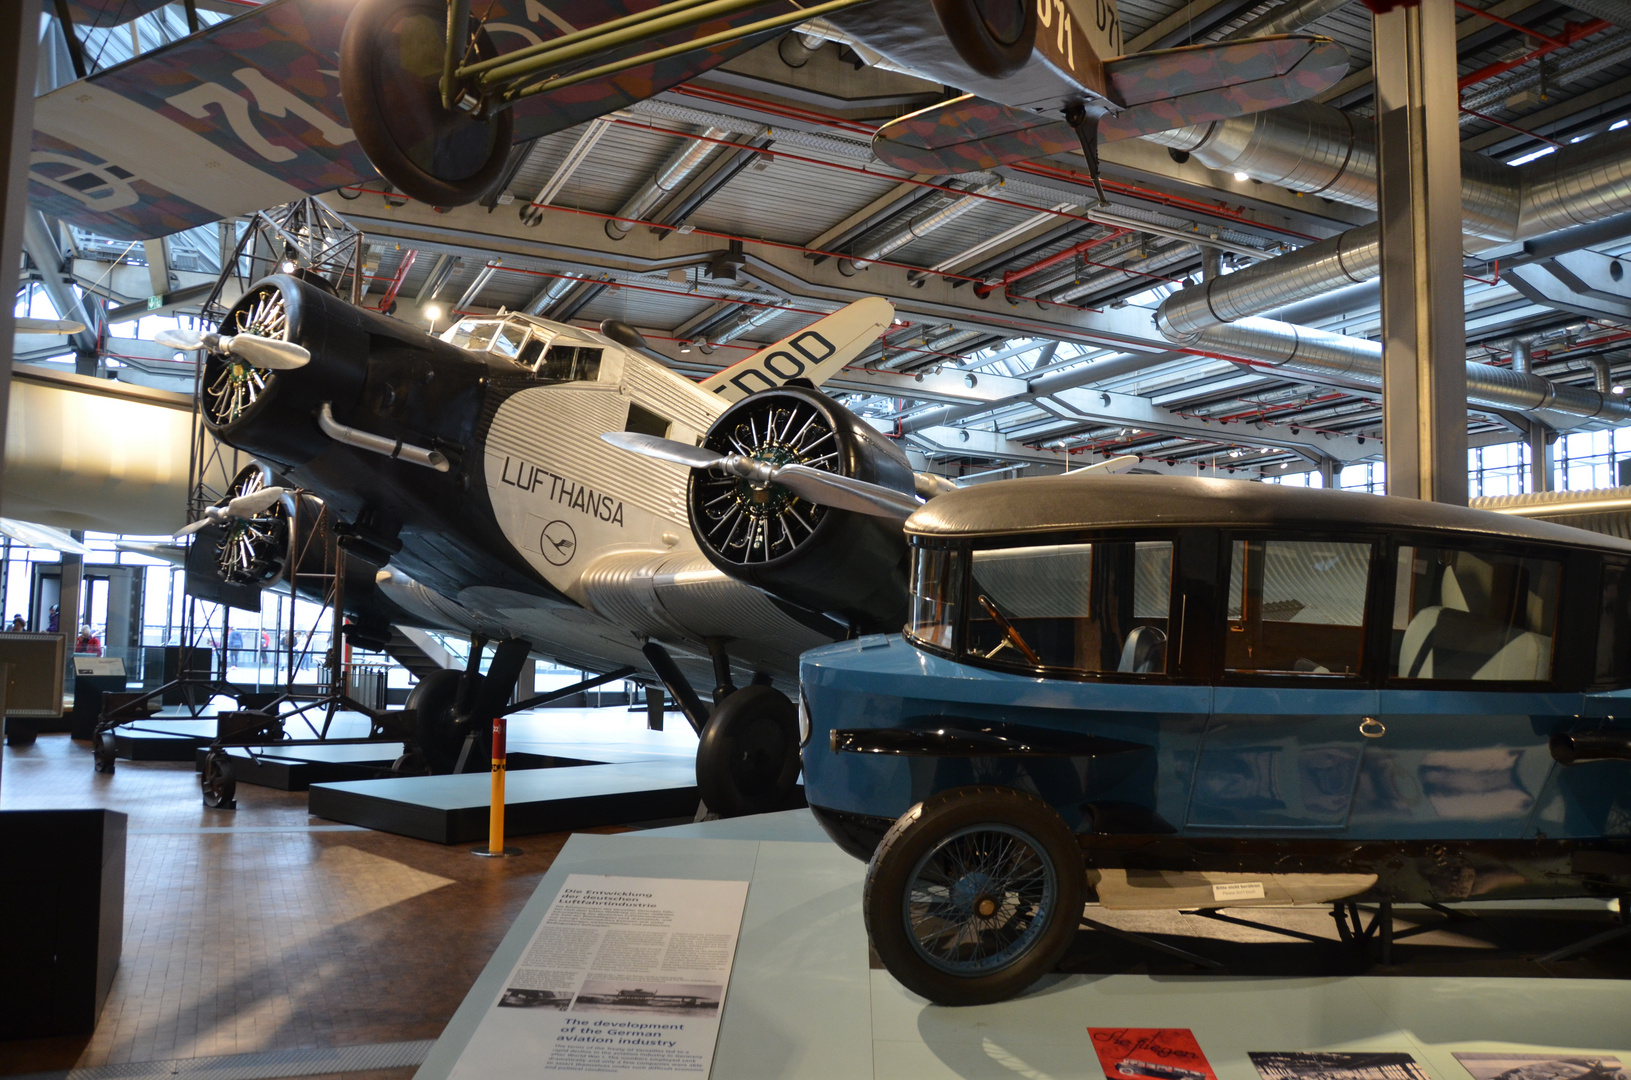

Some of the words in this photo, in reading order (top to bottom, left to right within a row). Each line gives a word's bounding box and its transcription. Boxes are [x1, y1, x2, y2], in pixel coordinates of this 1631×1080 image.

[712, 330, 836, 396] DOD
[501, 456, 624, 528] LUFTHANSA
[586, 890, 653, 898] Entwicklung
[559, 899, 656, 907] Luftfahrtindustrie
[594, 1020, 684, 1030] development
[608, 1029, 662, 1037] German
[556, 1035, 613, 1043] aviation
[618, 1037, 676, 1047] industry
